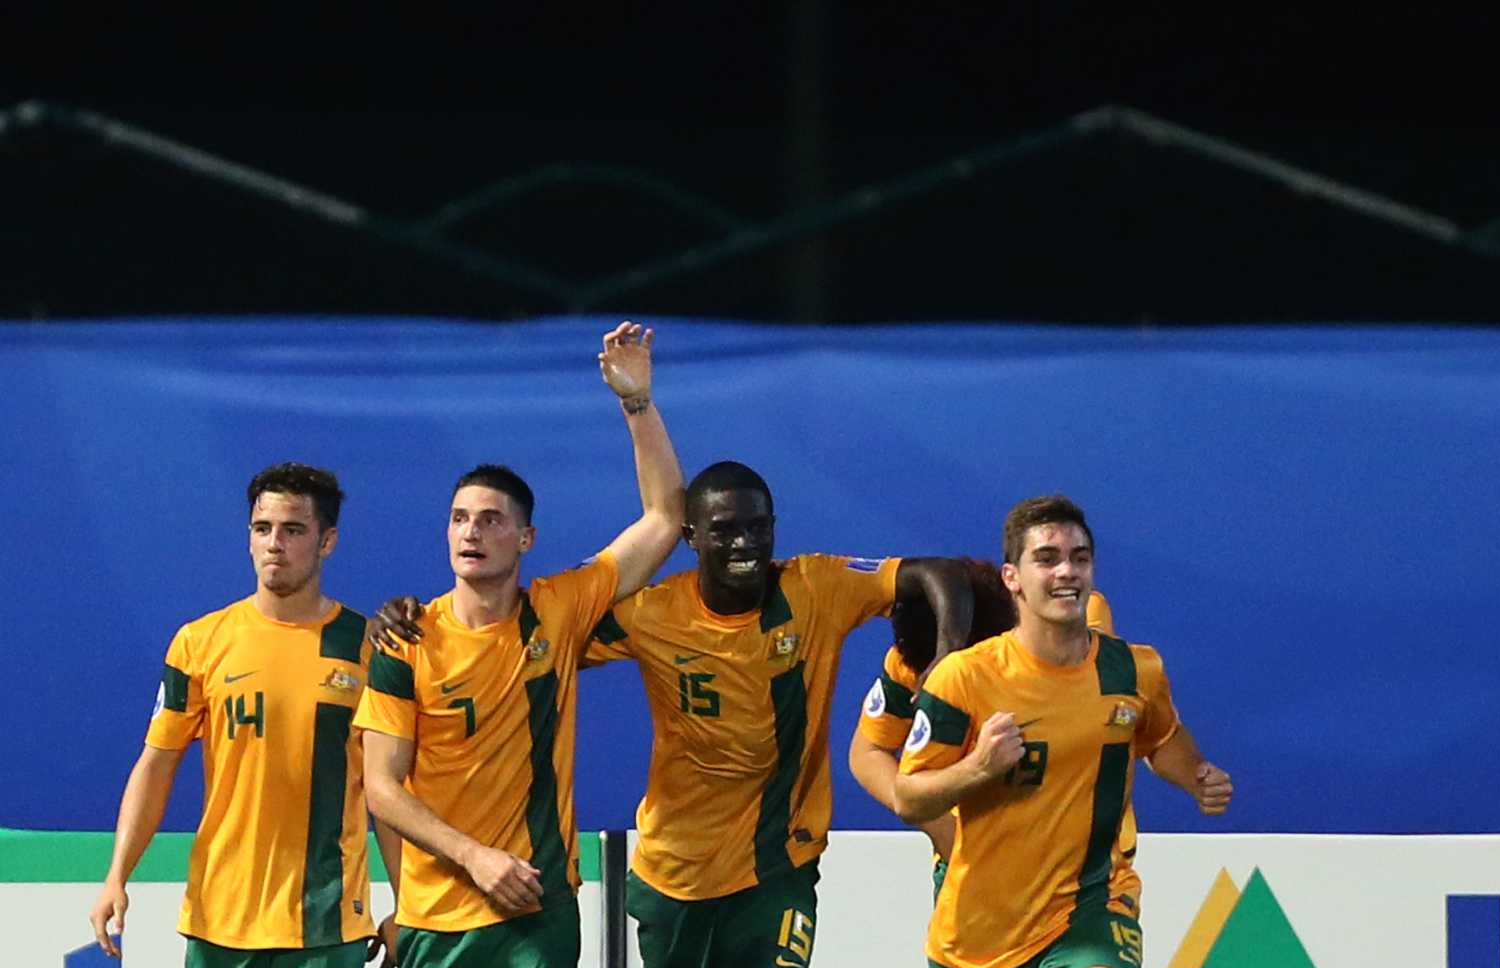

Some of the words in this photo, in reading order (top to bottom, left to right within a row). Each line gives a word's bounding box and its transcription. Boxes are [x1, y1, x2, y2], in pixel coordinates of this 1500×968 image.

[225, 691, 265, 740] 14
[447, 697, 476, 738] 7
[679, 671, 721, 718] 15
[1006, 741, 1049, 786] 9
[777, 908, 813, 962] 15
